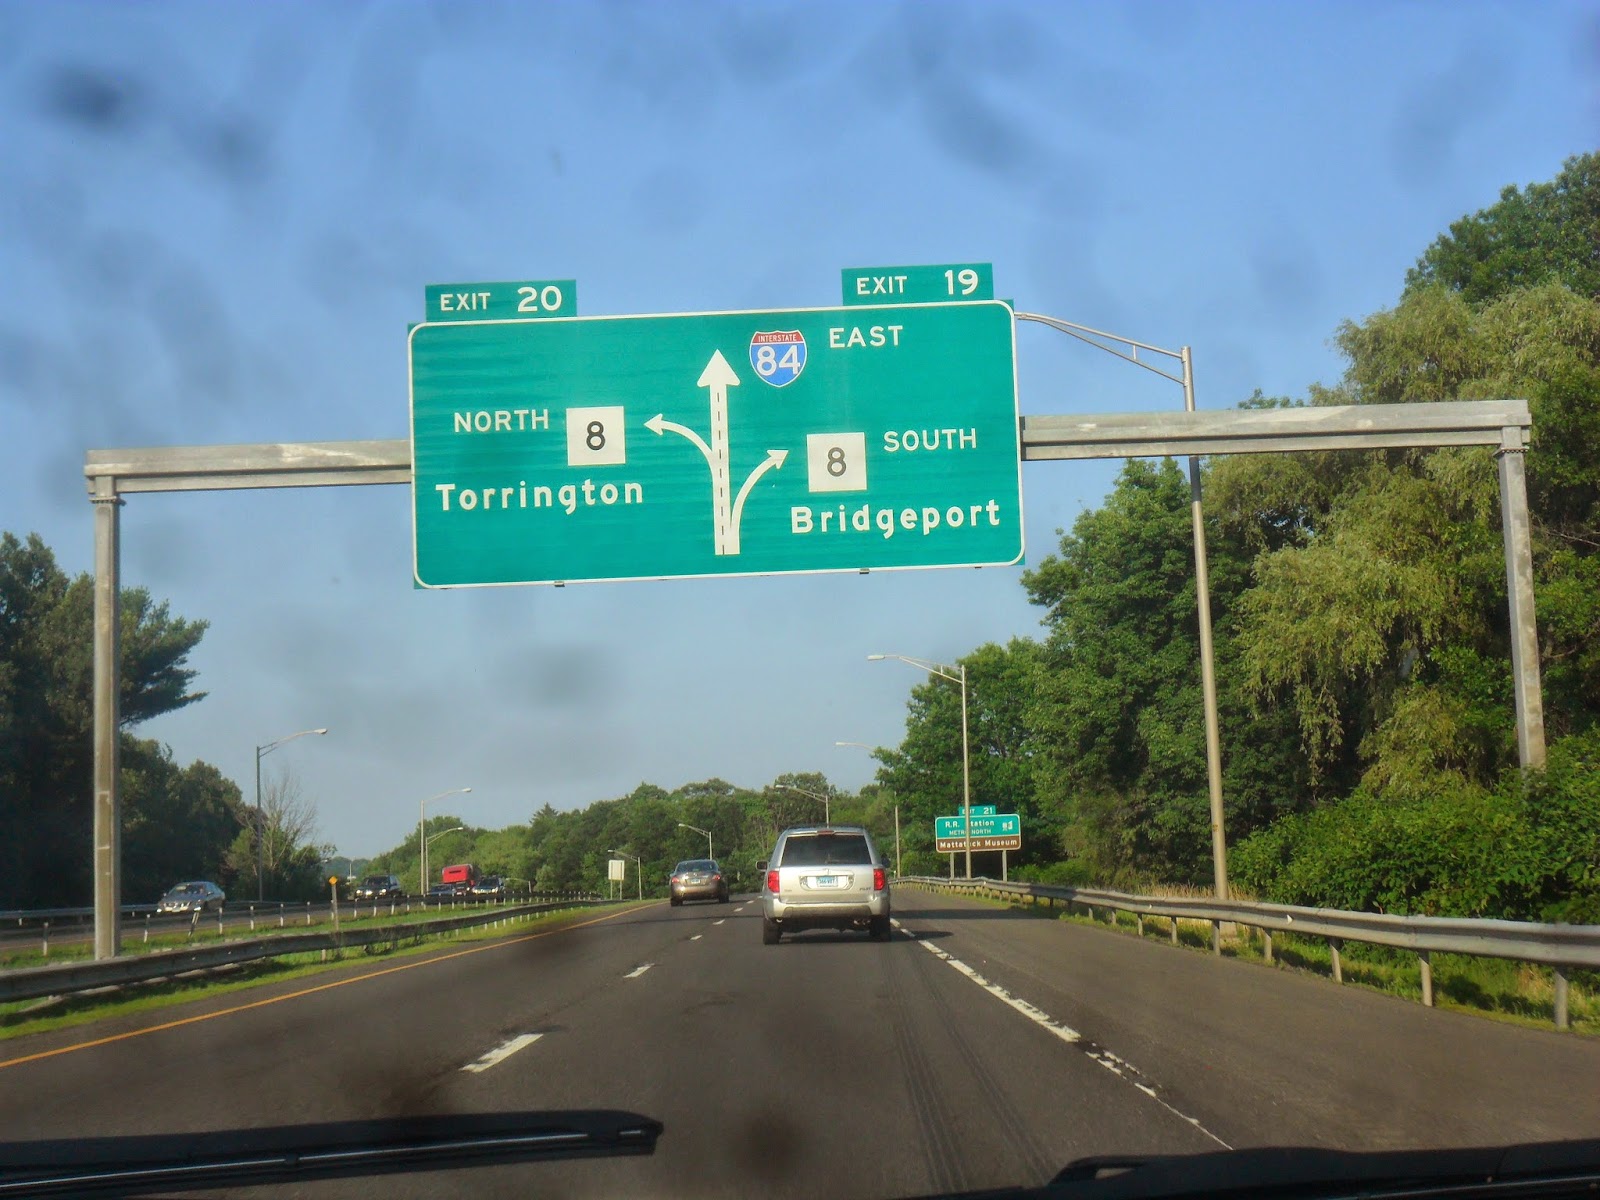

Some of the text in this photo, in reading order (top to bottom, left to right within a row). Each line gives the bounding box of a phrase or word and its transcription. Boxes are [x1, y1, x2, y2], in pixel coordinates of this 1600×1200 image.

[856, 269, 979, 296] EXIT 19
[440, 285, 564, 313] EXIT 20
[758, 333, 798, 343] INTERSTATE
[829, 325, 904, 349] EAST
[756, 343, 801, 377] 84
[454, 408, 549, 433] NORTH
[586, 420, 606, 451] 8
[883, 427, 978, 453] SOUTH
[827, 447, 847, 477] 8
[435, 478, 644, 515] Torrington
[790, 499, 1001, 539] Bridgeport
[968, 819, 995, 827] tation
[983, 807, 993, 815] 21
[984, 839, 1017, 847] Museum
